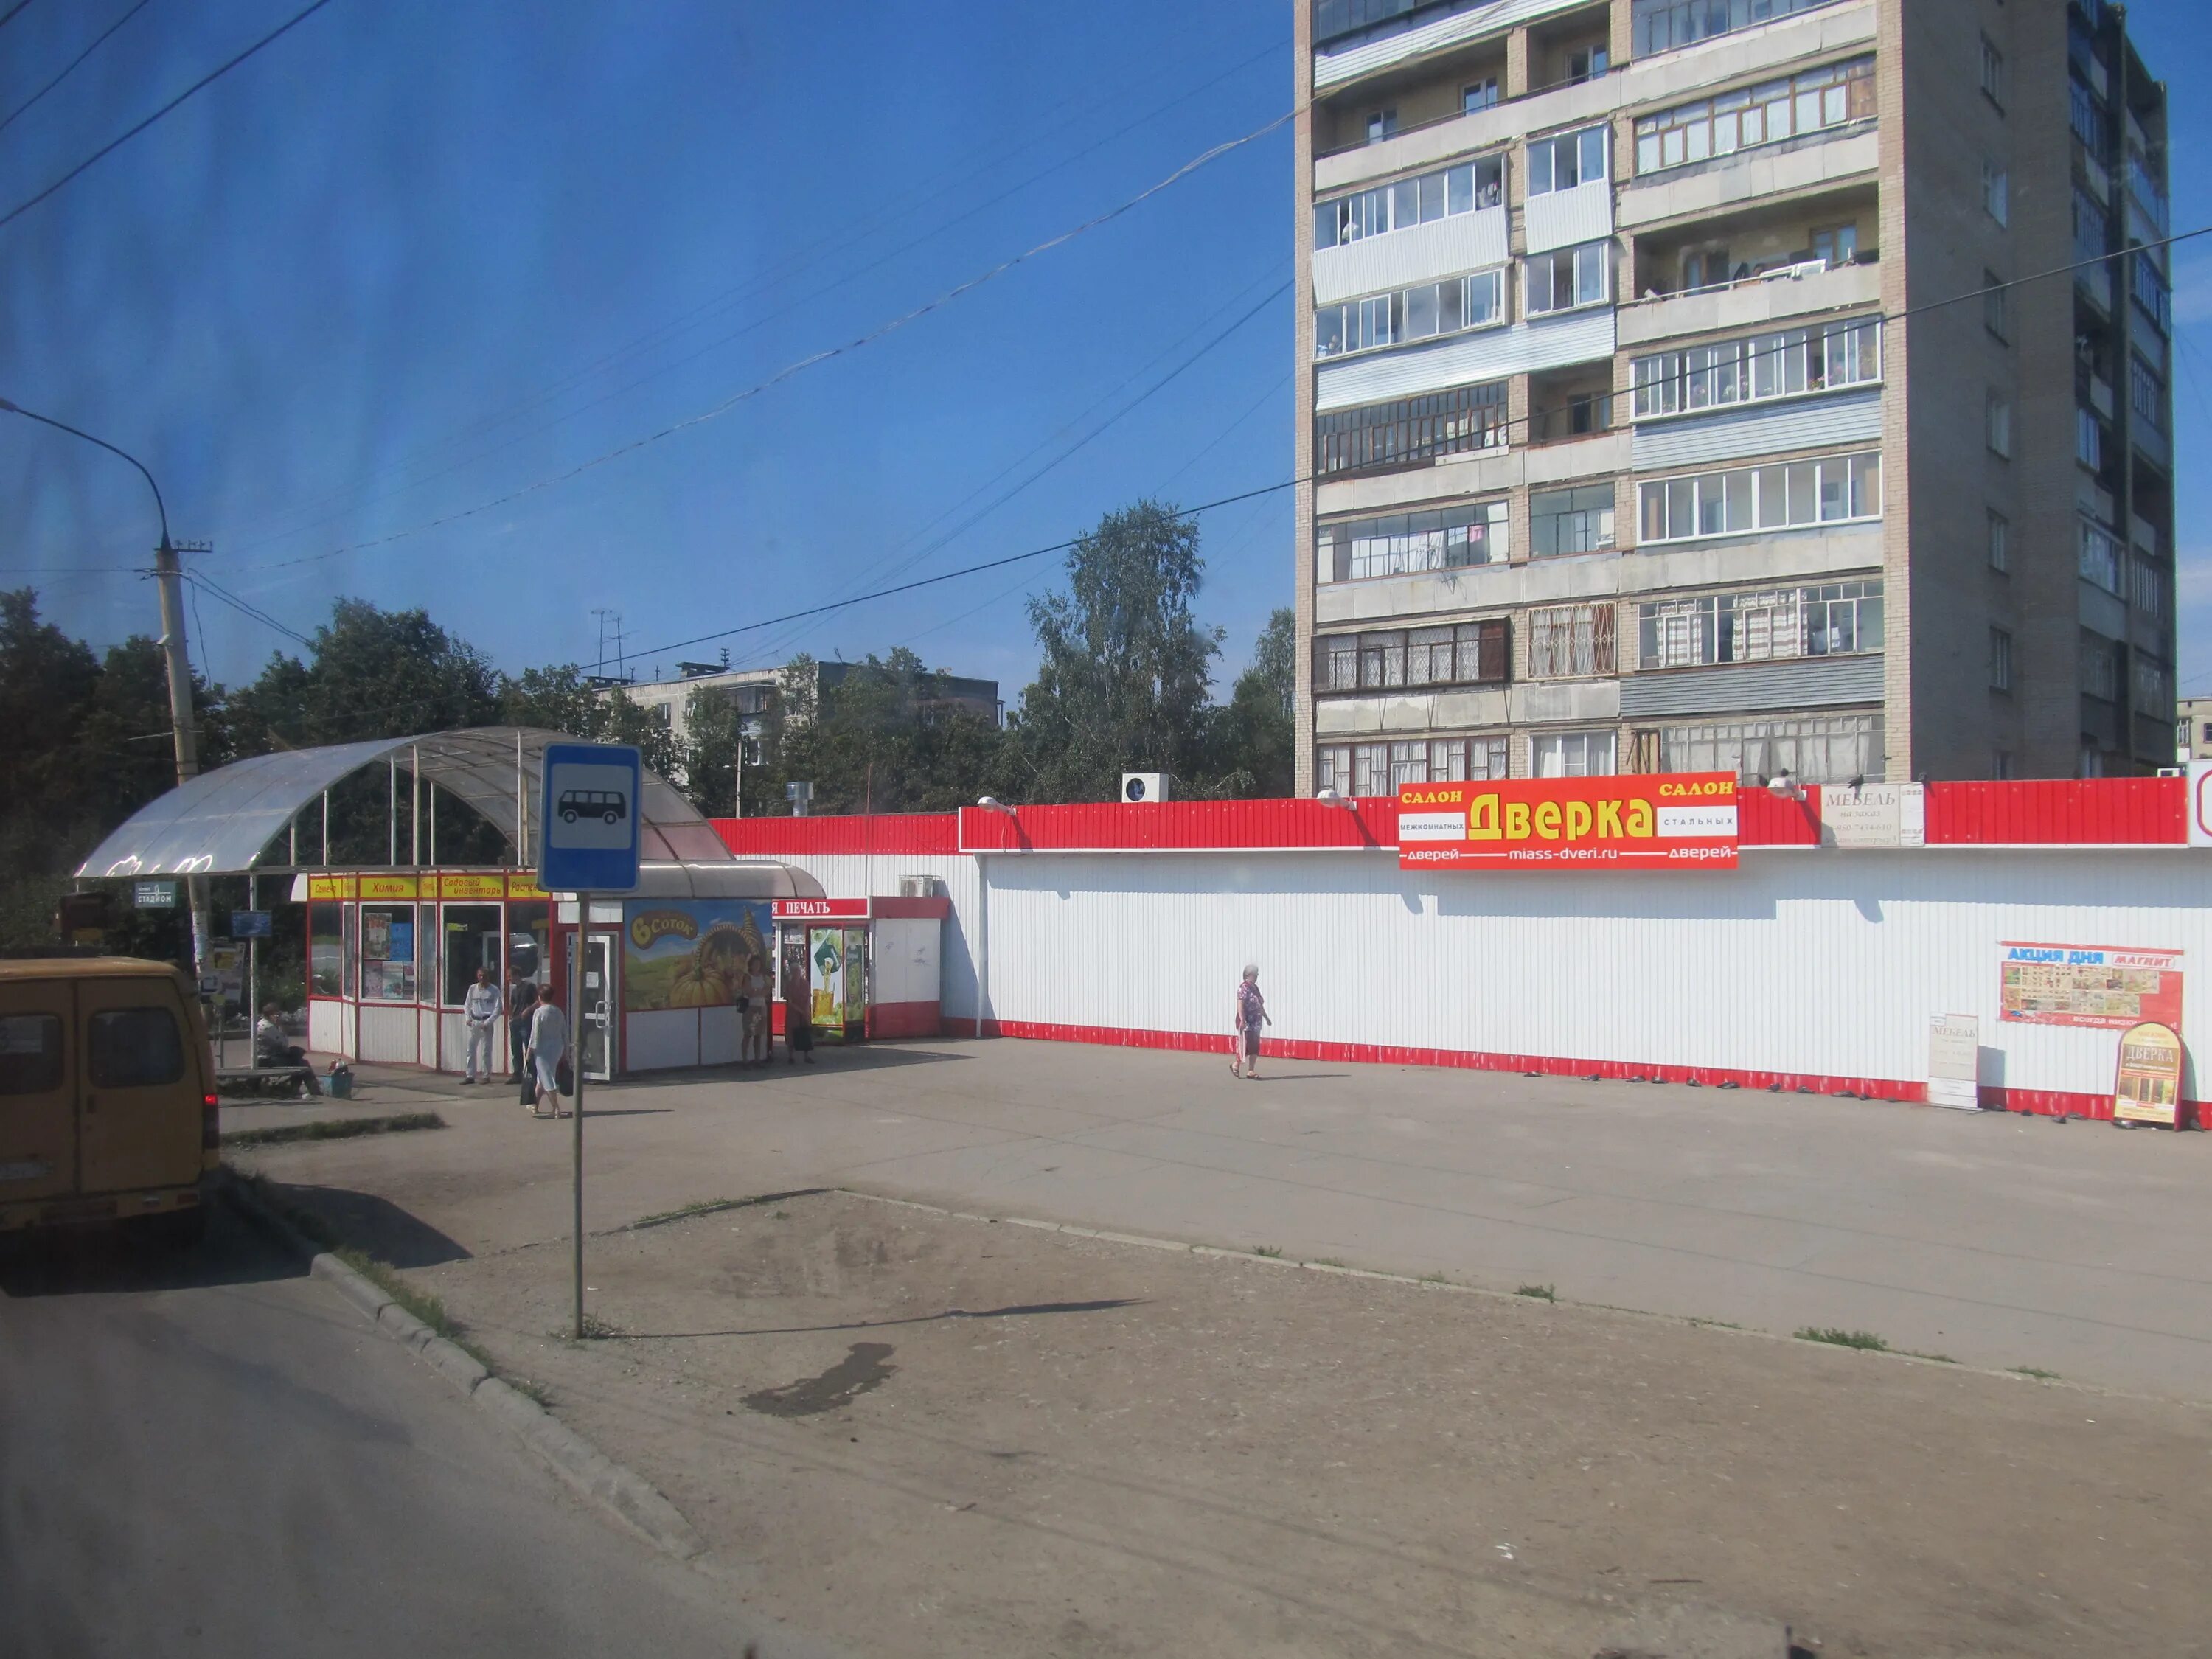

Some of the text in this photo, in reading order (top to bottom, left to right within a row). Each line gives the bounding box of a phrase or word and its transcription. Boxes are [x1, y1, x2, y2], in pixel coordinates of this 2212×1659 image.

[1659, 781, 1734, 797] САЛОН
[1401, 790, 1462, 804] САЛОН
[1826, 793, 1896, 807] МЕБЕЛЬ
[1468, 793, 1655, 841] Дверка
[1664, 818, 1733, 827] СТАЛЬНЫХ
[1400, 821, 1465, 832] МЕЖКОМНАТНЫХ
[1408, 847, 1459, 861] дверей
[1509, 846, 1618, 860] miass-dveri.ru
[1669, 845, 1731, 859] дверей
[372, 883, 404, 893] Химия
[444, 877, 481, 886] Садовый
[512, 882, 538, 891] Растен
[454, 886, 501, 895] инвентарь
[138, 895, 172, 903] СТАДИОН
[786, 902, 830, 914] ПЕЧАТЬ
[632, 917, 651, 945] 6
[2008, 948, 2104, 964] АКЦИЯ ДНЯ
[2114, 955, 2173, 967] МАГНИТ
[2126, 1046, 2174, 1062] ДВЕРКА
